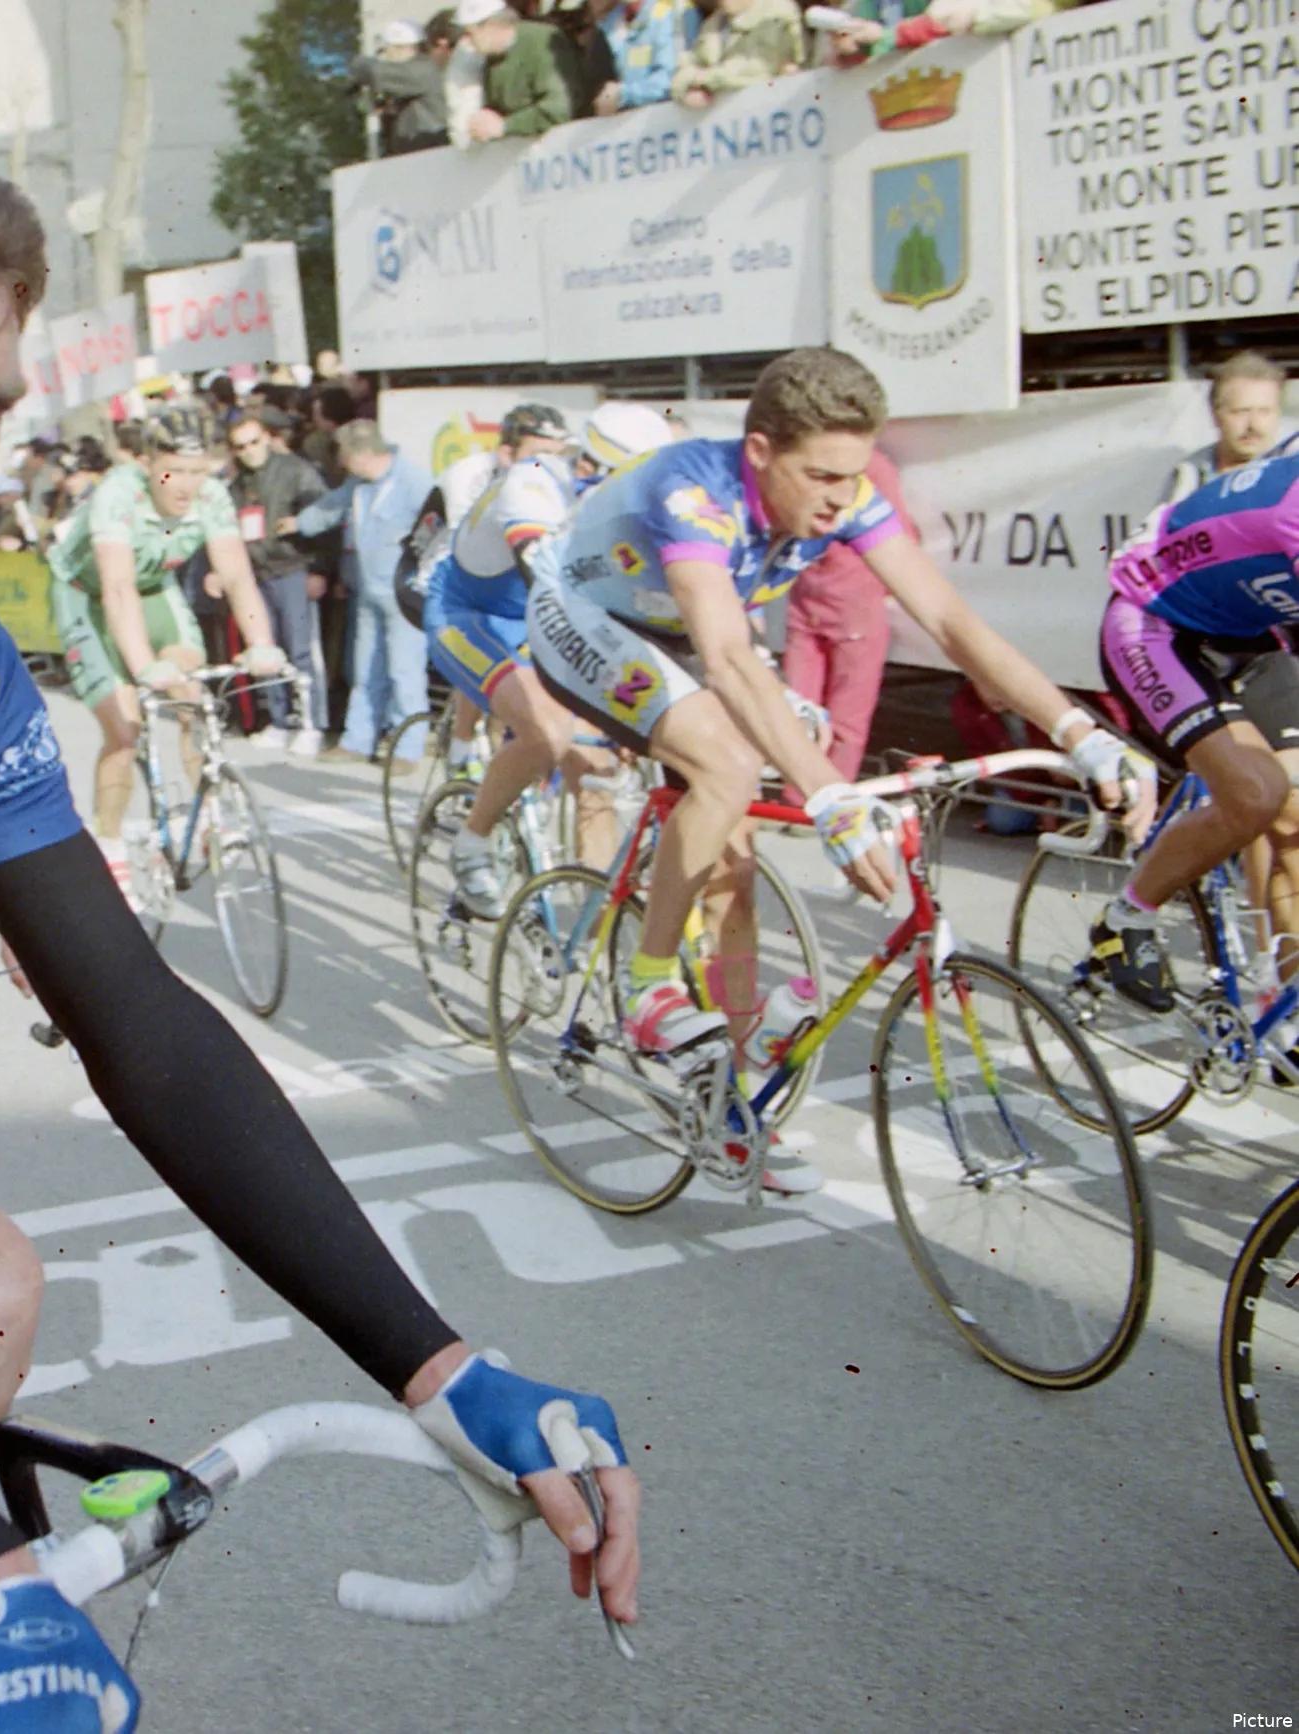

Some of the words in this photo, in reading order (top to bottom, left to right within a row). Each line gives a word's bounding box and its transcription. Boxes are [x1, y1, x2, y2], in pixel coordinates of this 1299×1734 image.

[1026, 2, 1170, 77] Amm.ni
[521, 106, 825, 195] MONTEGRANARO
[1046, 111, 1162, 166] TORRE
[1184, 93, 1262, 146] SAN
[1078, 154, 1230, 213] MONTE
[1036, 222, 1153, 271] MONTE
[1174, 216, 1208, 258] S.
[151, 289, 272, 346] TOCCA
[1041, 283, 1076, 322] S.
[1097, 263, 1262, 317] ELPIDIO
[1006, 511, 1078, 569] DA
